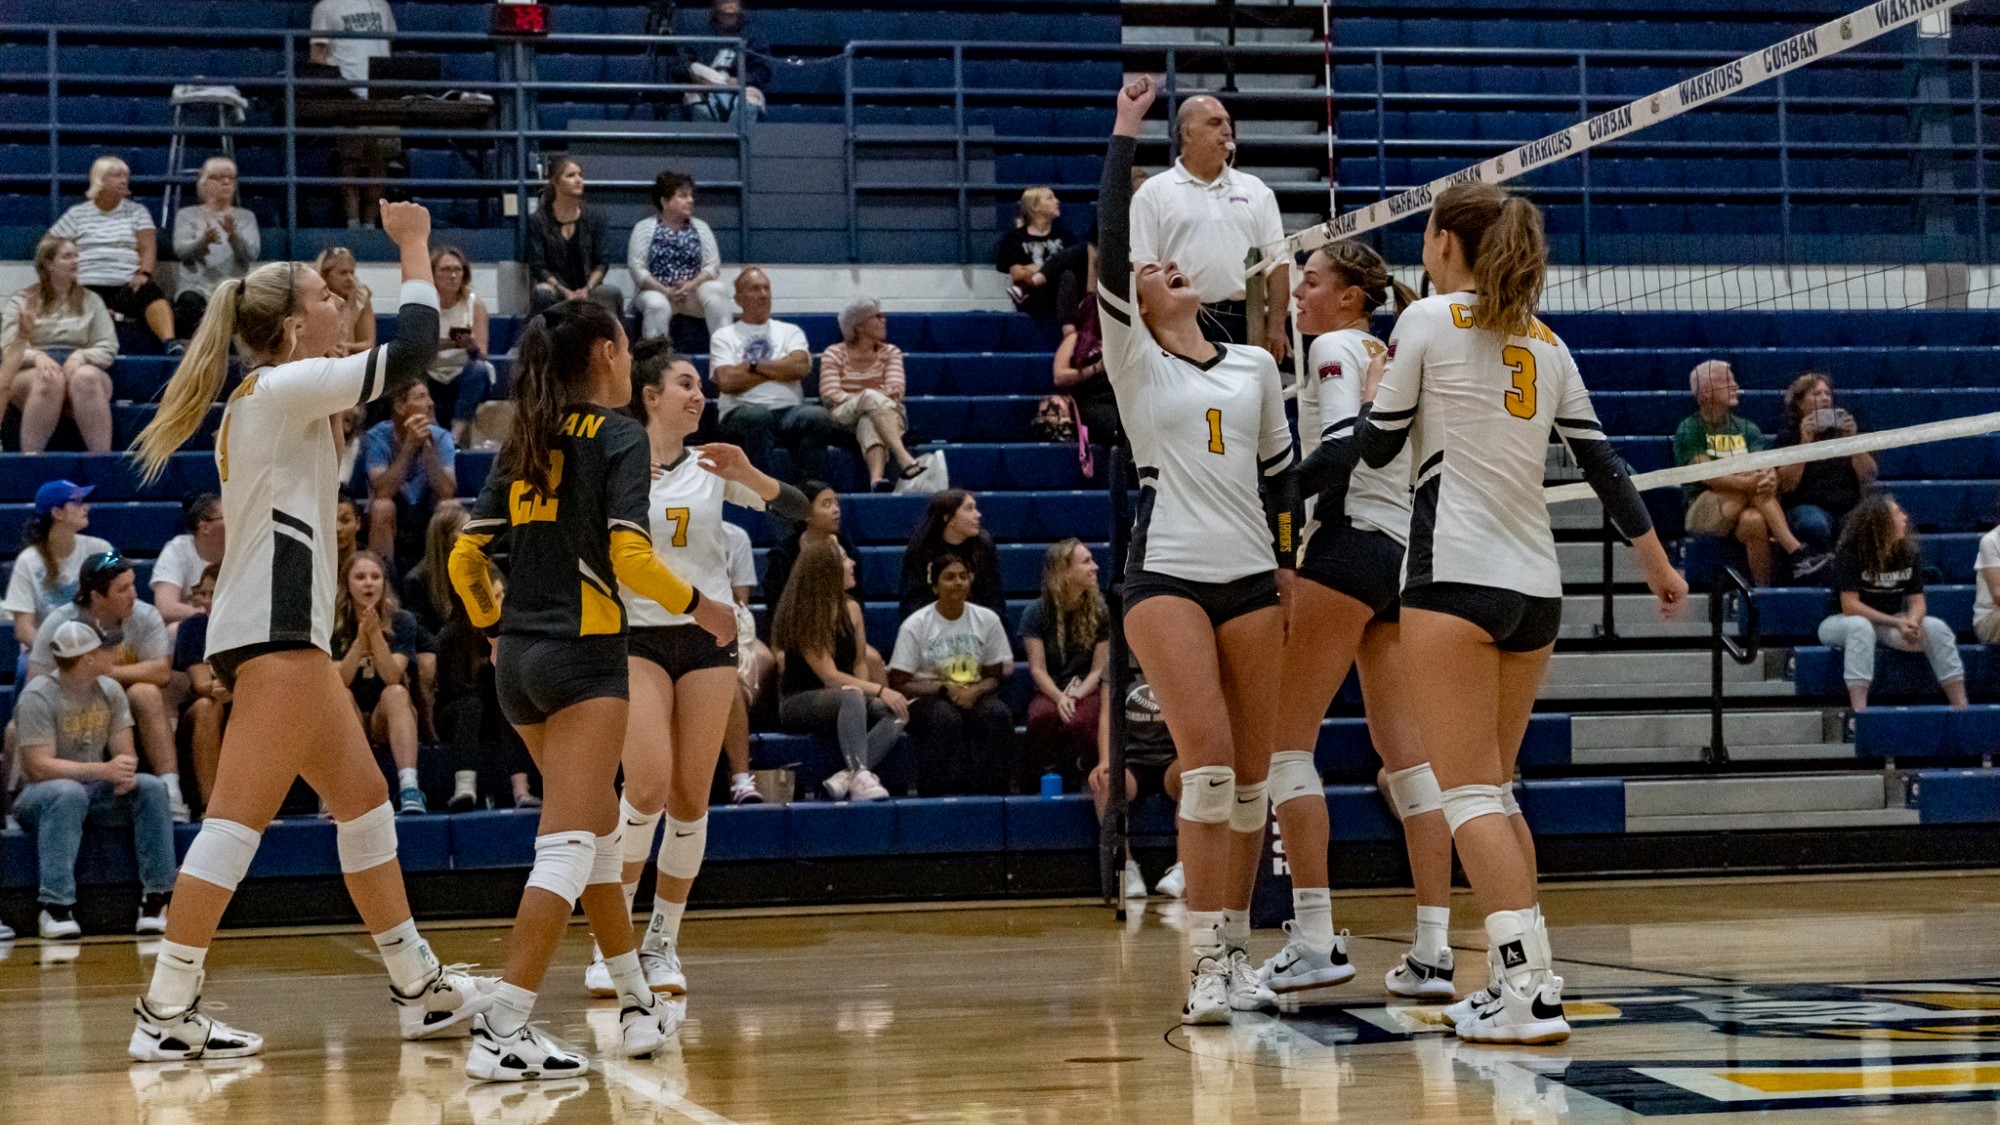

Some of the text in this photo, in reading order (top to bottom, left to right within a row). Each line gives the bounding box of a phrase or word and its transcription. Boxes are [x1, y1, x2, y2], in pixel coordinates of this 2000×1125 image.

[1388, 184, 1433, 217] WARRIORS
[1518, 129, 1572, 168] WARRIORS
[1588, 103, 1632, 141] CORBAN
[1679, 60, 1743, 106] WARRIORS
[1763, 30, 1818, 74] CORBAN
[1502, 344, 1537, 420] 3
[1206, 408, 1225, 455] 1
[665, 507, 690, 547] 7
